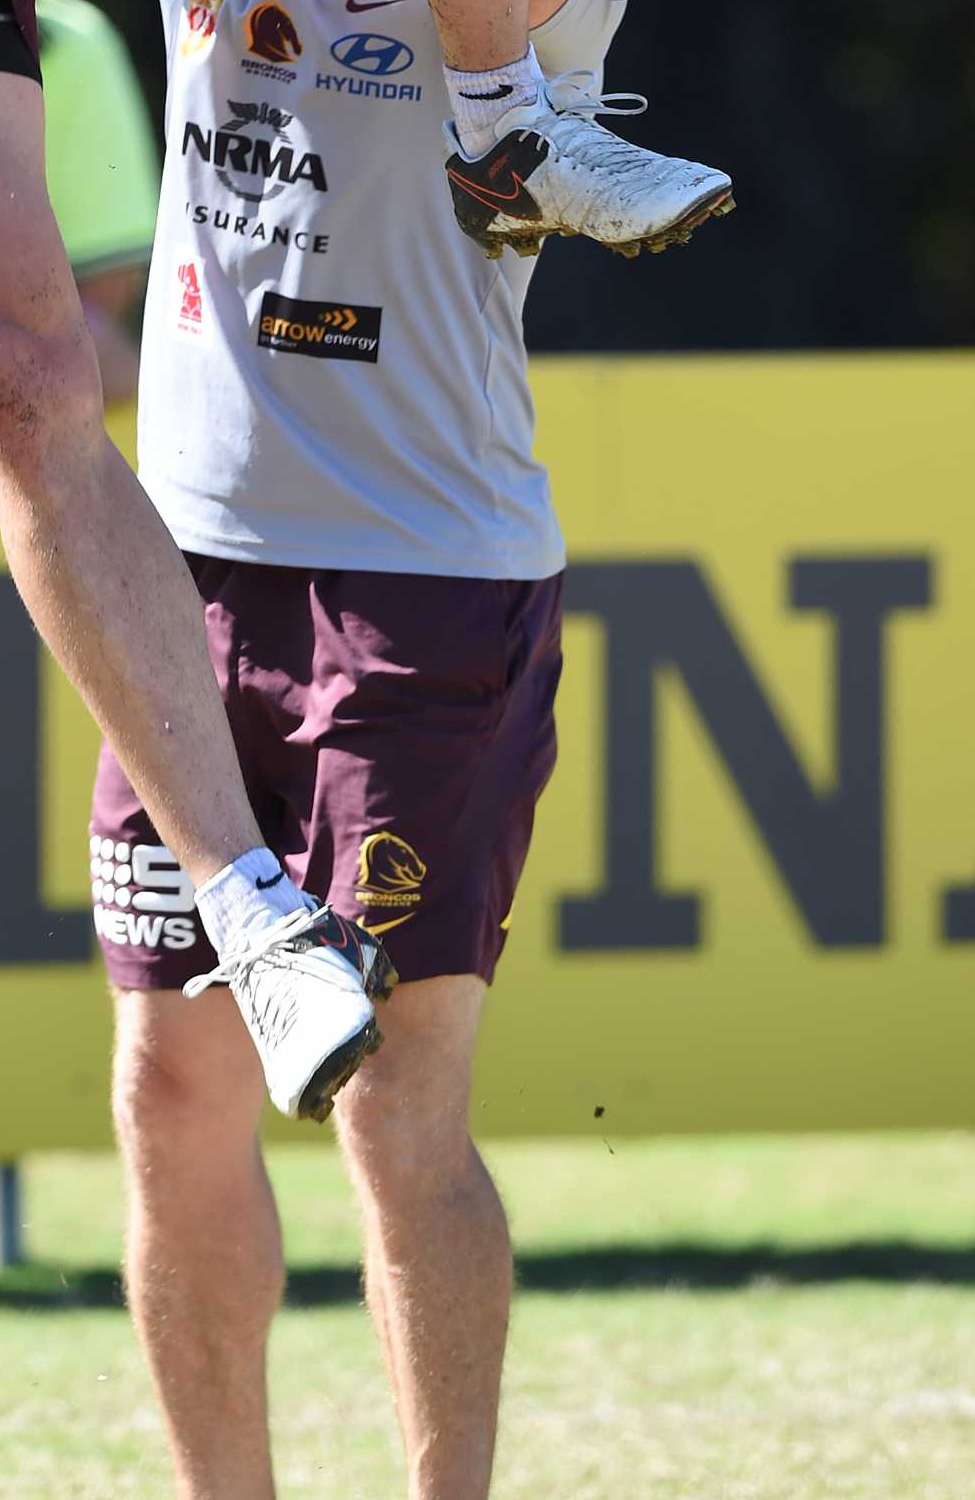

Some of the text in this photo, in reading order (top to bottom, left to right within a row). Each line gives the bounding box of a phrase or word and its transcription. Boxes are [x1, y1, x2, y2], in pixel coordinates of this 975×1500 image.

[316, 73, 422, 101] HYUNDAI
[182, 121, 328, 192] NRMA
[186, 202, 330, 253] SURANCE
[94, 904, 196, 950] NEWS
